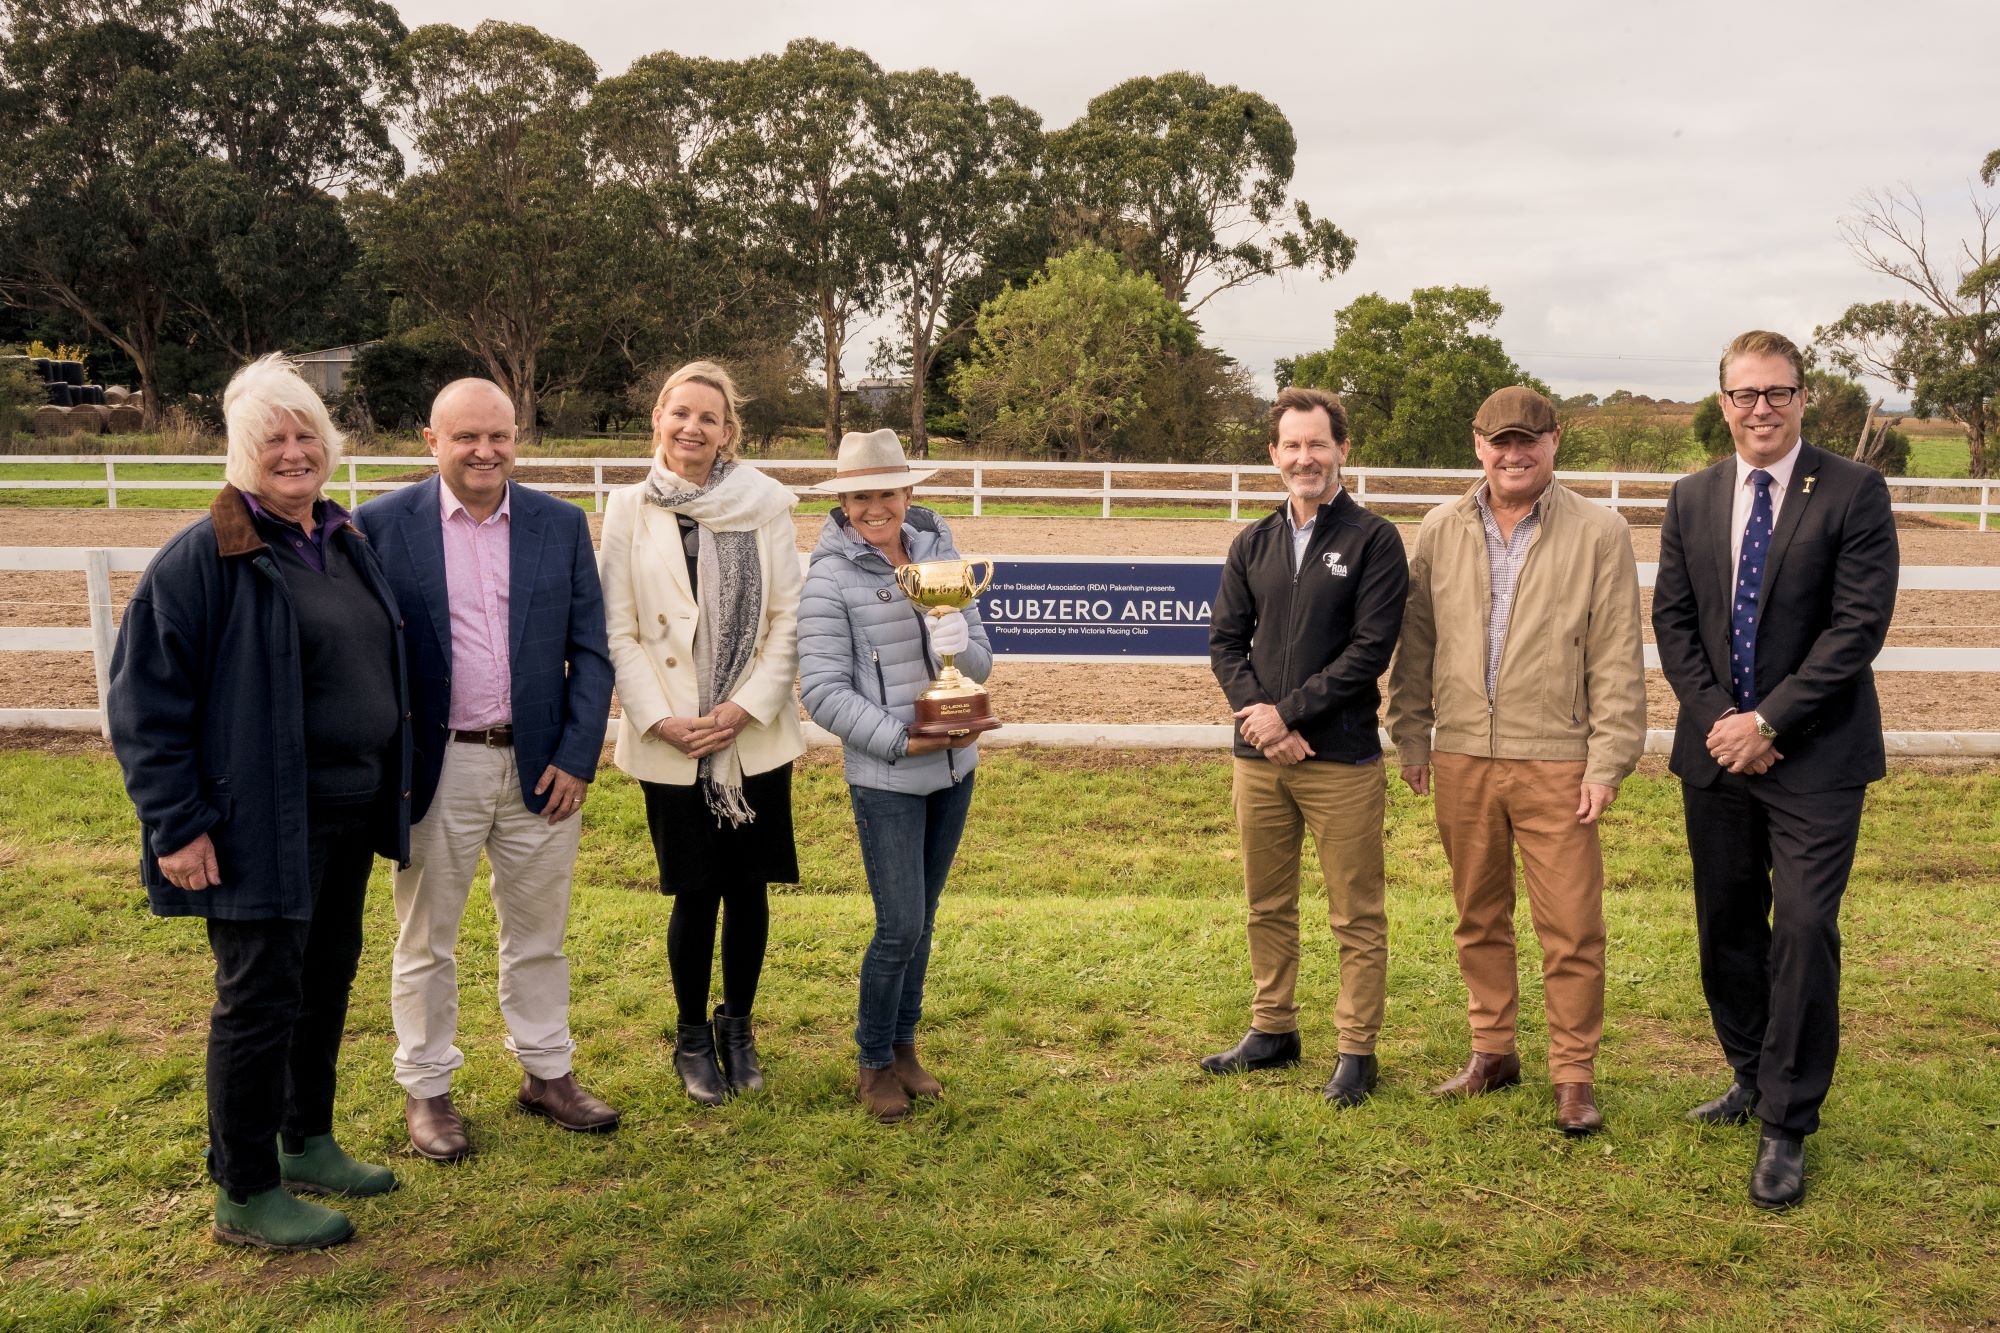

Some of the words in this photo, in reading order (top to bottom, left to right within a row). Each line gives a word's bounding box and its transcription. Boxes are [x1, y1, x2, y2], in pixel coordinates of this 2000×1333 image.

[1331, 564, 1347, 574] RDA
[992, 582, 1002, 590] for
[1016, 583, 1046, 591] Disabled
[1047, 583, 1086, 591] Association
[1087, 583, 1108, 592] (RDA)
[1146, 585, 1176, 593] presents
[990, 599, 1113, 620] SUBZERO
[1121, 600, 1212, 621] ARENA
[995, 626, 1021, 635] Proudly
[1022, 626, 1057, 636] supported
[1057, 627, 1067, 636] by
[1068, 627, 1079, 635] the
[1080, 627, 1106, 635] Victoria
[1106, 627, 1131, 636] Racing
[1131, 627, 1149, 635] Club
